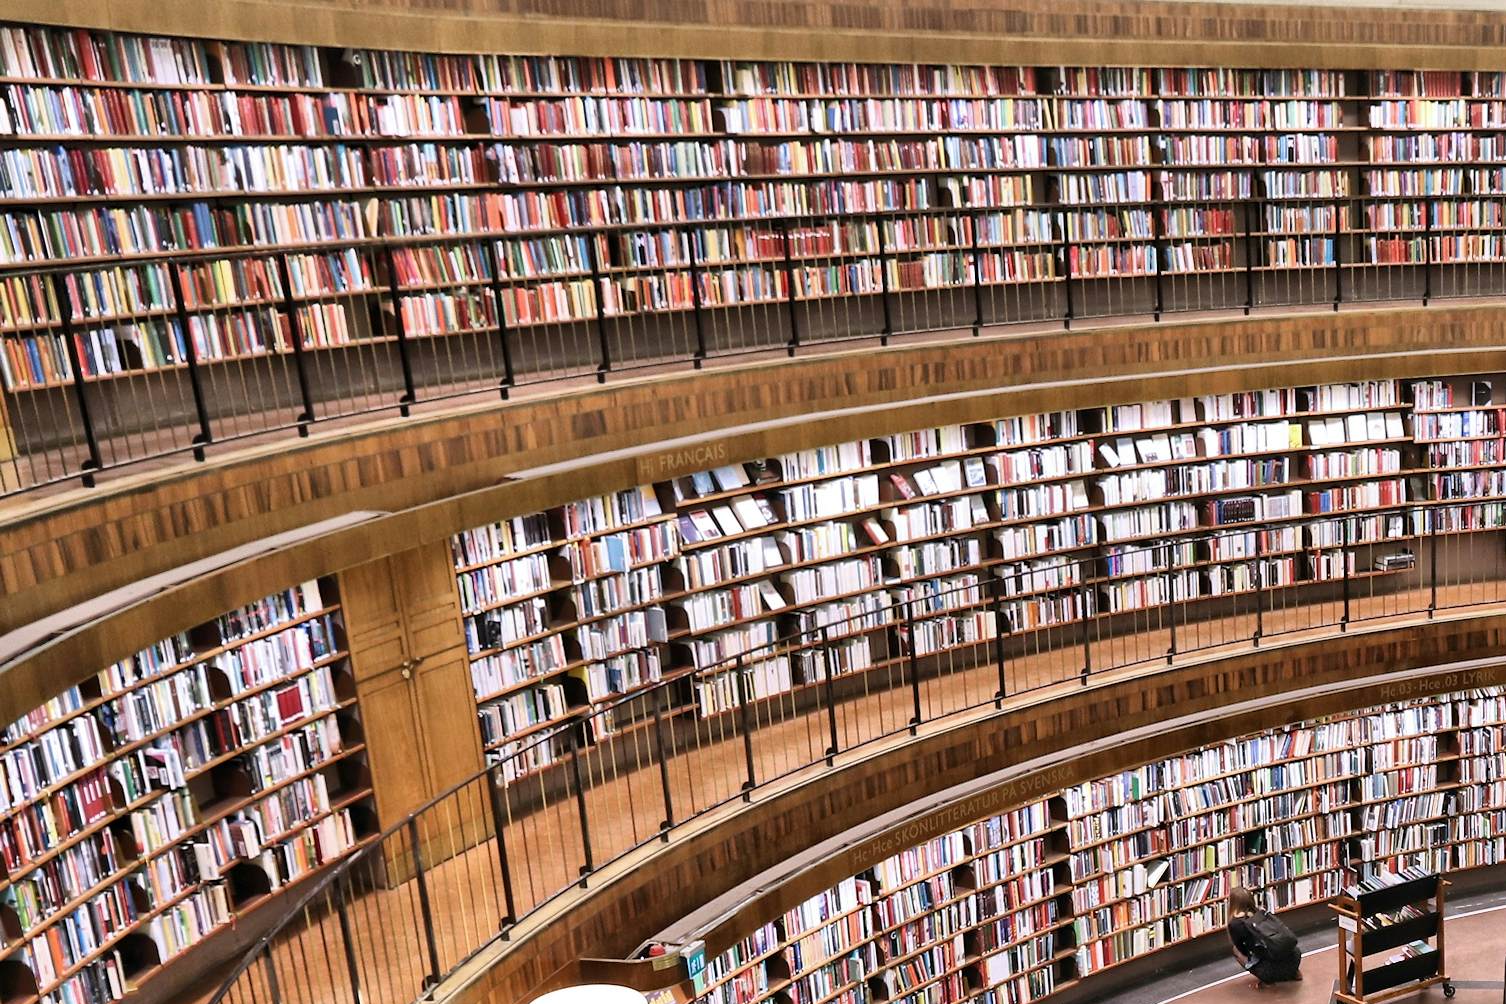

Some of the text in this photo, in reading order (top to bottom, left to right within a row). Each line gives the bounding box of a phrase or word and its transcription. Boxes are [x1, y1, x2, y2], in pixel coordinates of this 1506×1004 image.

[660, 443, 726, 473] FRANÇAIS
[1463, 670, 1496, 685] LYRIK
[1021, 766, 1075, 794] SVENSKA
